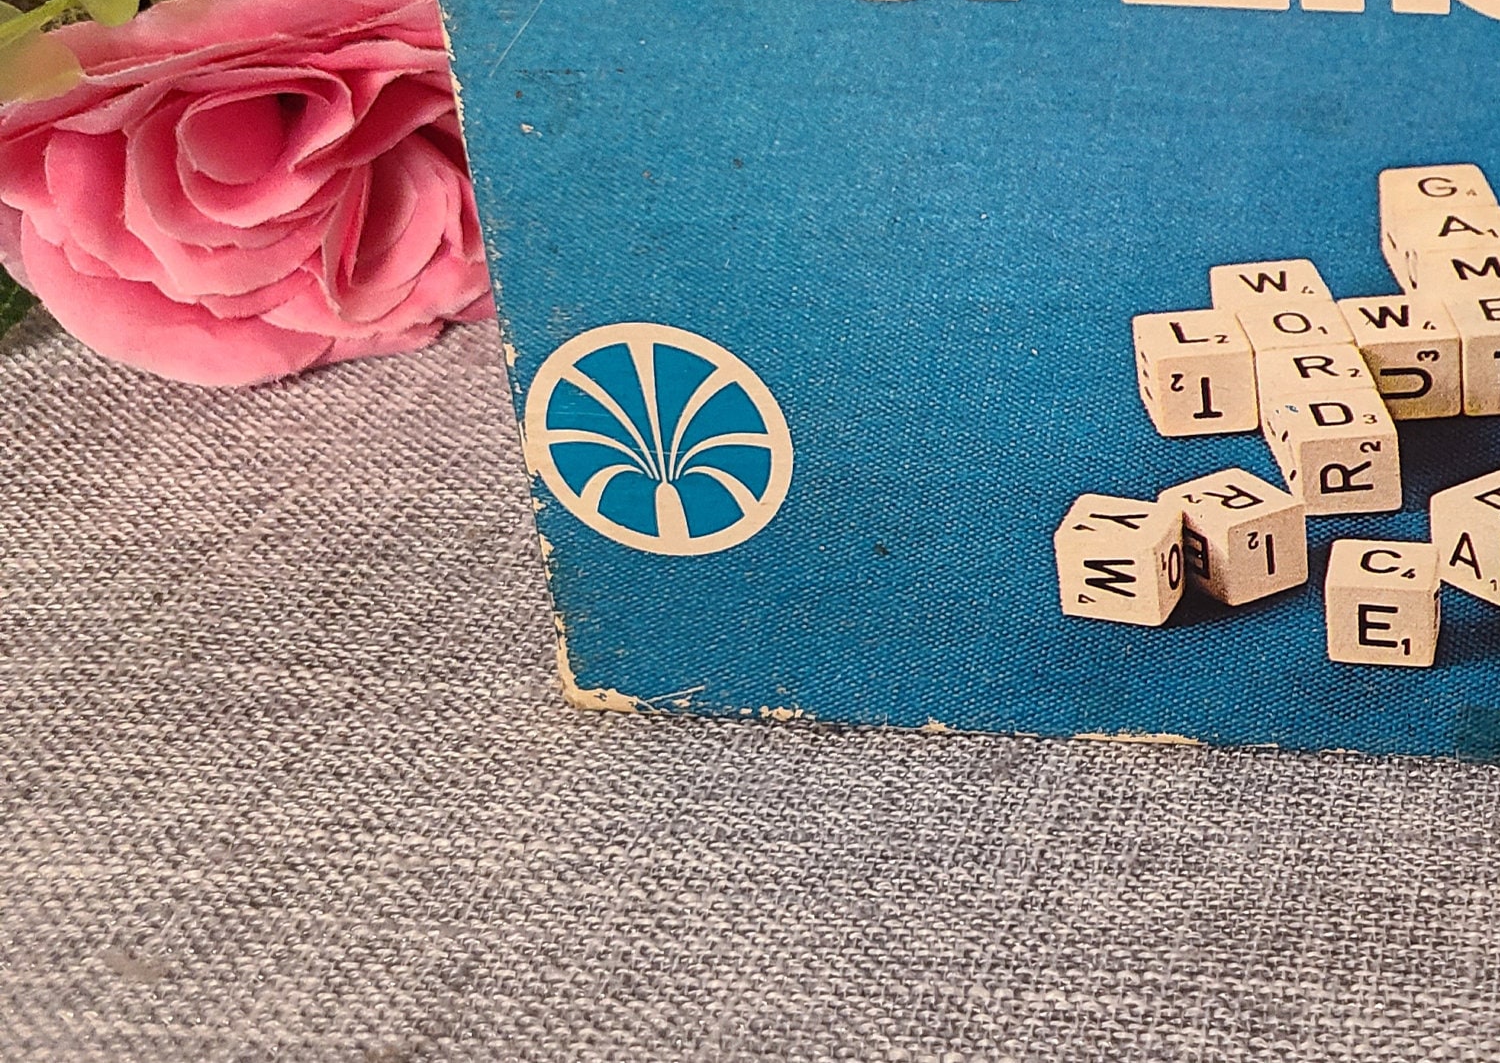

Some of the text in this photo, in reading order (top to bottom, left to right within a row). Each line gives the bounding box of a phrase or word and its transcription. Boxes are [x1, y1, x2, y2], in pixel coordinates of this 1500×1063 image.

[1418, 176, 1457, 198] G
[1438, 215, 1485, 237] A
[1239, 270, 1287, 293] W
[1273, 312, 1312, 334] O
[1359, 304, 1409, 329] W
[1169, 321, 1210, 344] L
[1293, 355, 1340, 379] R
[1192, 376, 1223, 419] T
[1308, 402, 1354, 427] D
[1320, 460, 1375, 494] R
[1202, 484, 1264, 510] R
[1360, 549, 1402, 574] C
[1449, 532, 1483, 580] A
[1358, 603, 1399, 648] E
